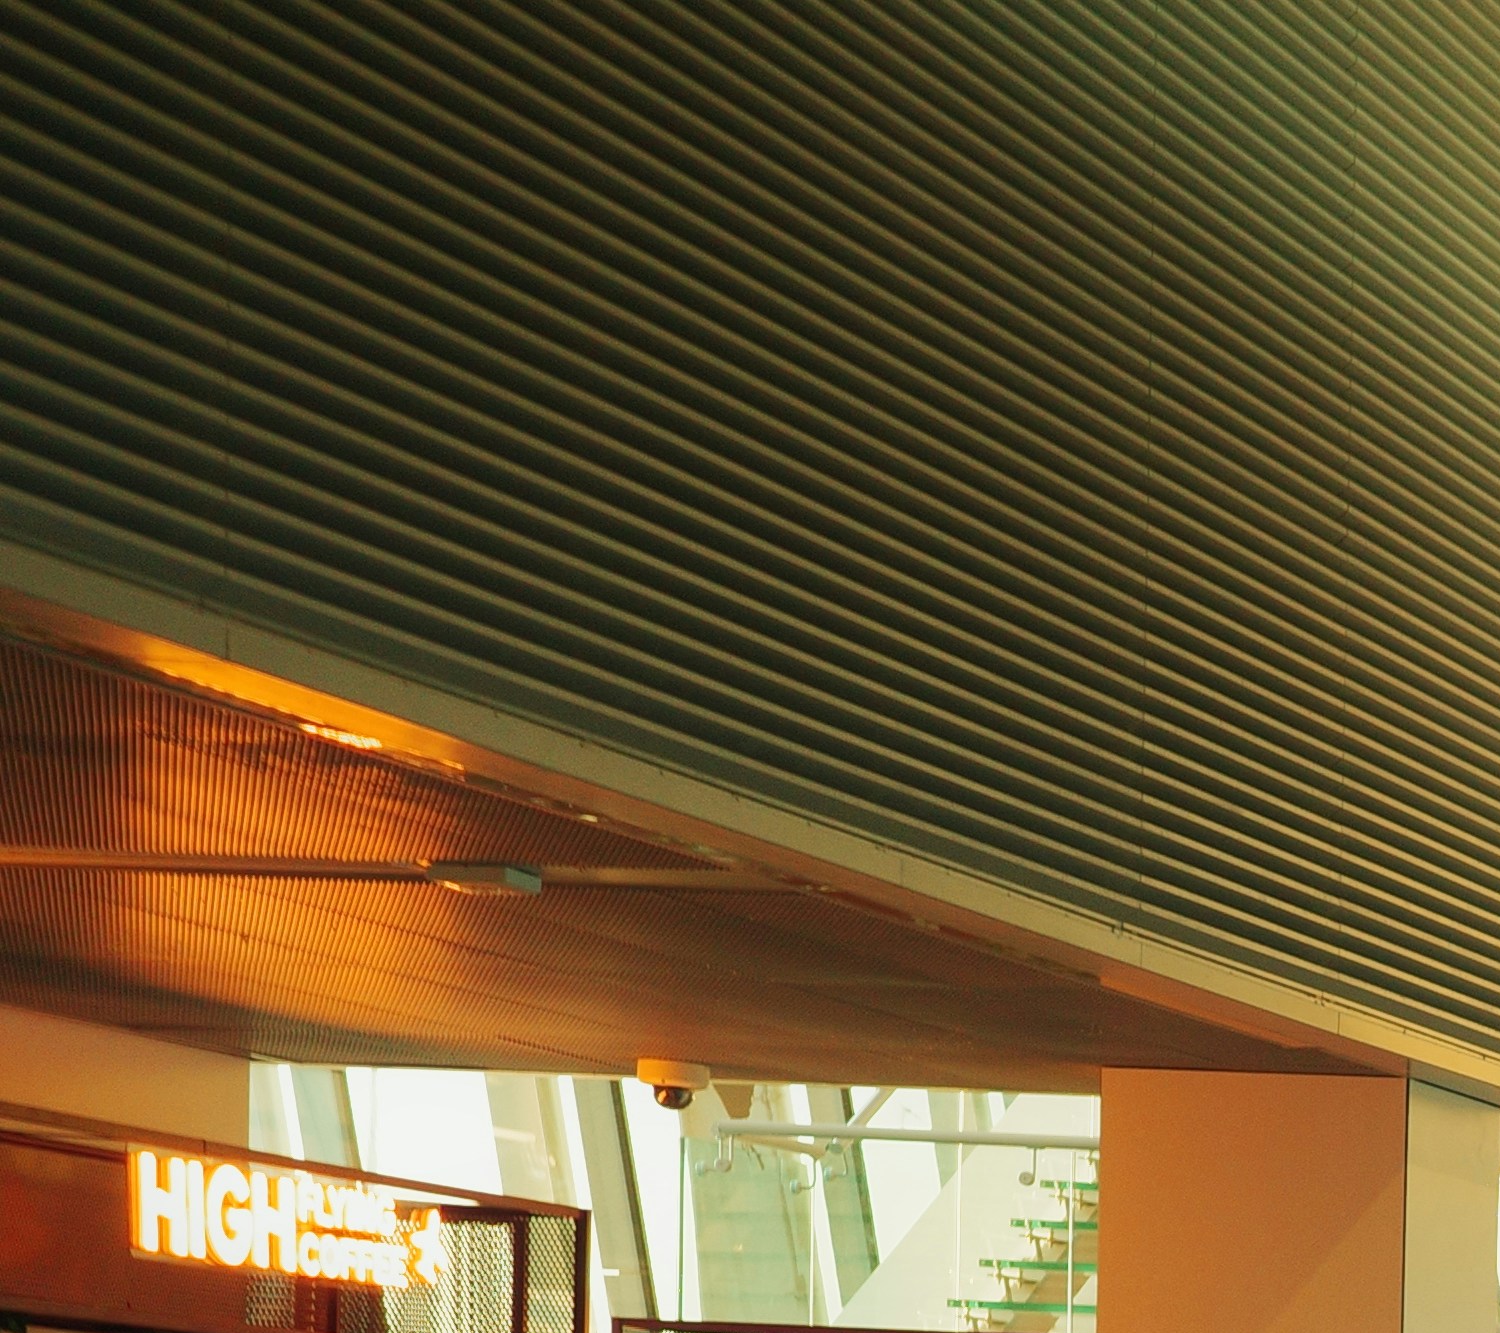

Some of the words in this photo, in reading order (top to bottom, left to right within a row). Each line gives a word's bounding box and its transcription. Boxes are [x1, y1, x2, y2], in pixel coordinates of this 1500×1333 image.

[139, 1151, 297, 1273] HIGH
[297, 1170, 396, 1237] FLYING
[299, 1231, 410, 1288] COFFEE
